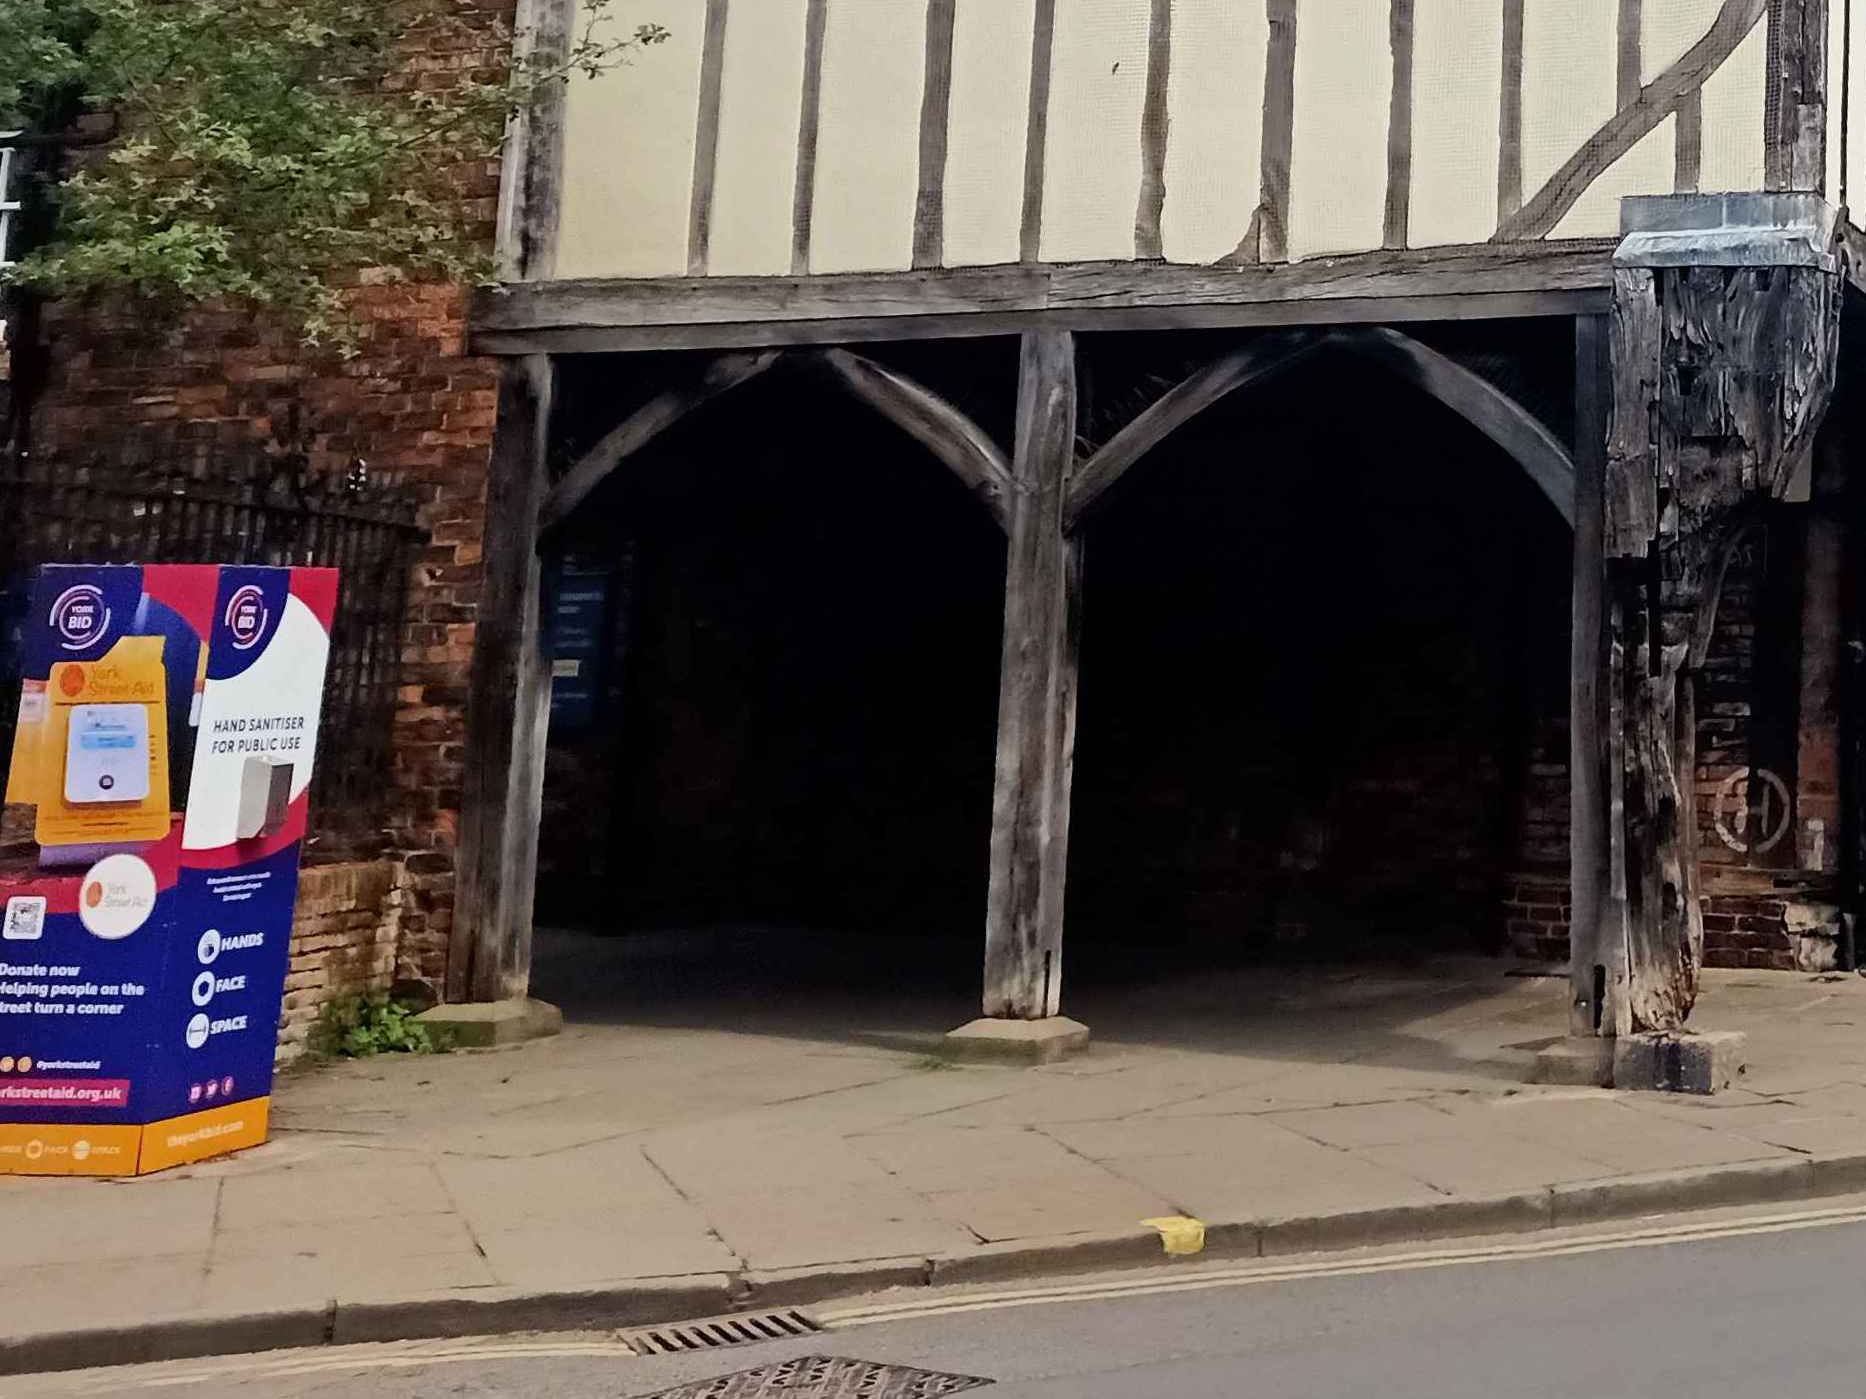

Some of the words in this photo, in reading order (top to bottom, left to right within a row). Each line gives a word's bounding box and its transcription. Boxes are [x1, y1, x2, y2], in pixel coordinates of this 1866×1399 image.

[68, 616, 92, 629] BID
[213, 719, 246, 733] HAND
[249, 716, 304, 732] SANITISER
[212, 739, 235, 753] FOR
[237, 738, 276, 752] PUBLIC
[280, 737, 301, 750] USE
[221, 932, 264, 951] HANDS
[0, 963, 48, 976] Donate
[49, 966, 80, 976] now
[50, 982, 98, 998] people
[100, 985, 119, 995] on
[121, 983, 145, 995] the
[216, 975, 246, 992] FACE
[0, 1001, 32, 1013] treet
[34, 1002, 64, 1014] turn
[65, 1004, 75, 1014] a
[77, 1004, 125, 1014] corner
[210, 1015, 248, 1034] SPACE
[0, 1086, 121, 1102] rkstreetaid.org.uk
